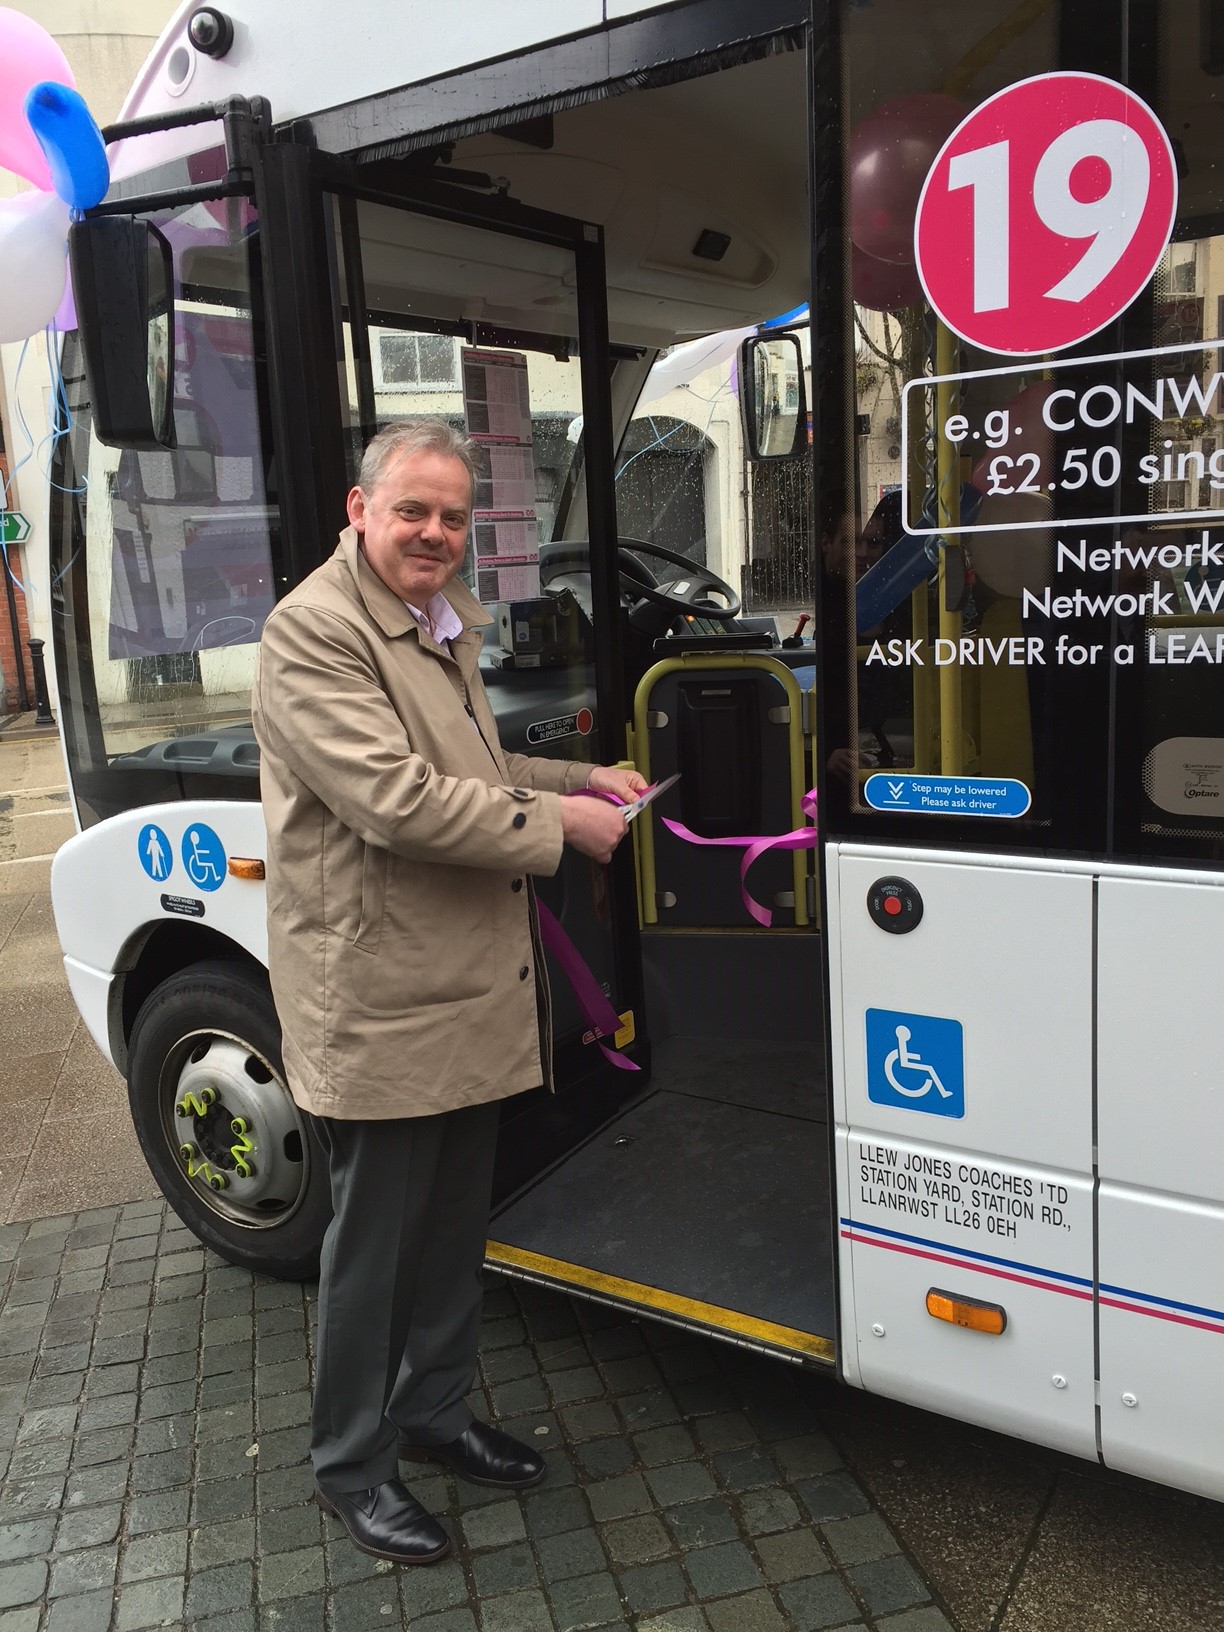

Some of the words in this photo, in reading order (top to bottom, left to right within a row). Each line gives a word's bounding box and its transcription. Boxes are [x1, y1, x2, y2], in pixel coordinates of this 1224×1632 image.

[948, 119, 1150, 313] 19
[944, 408, 1024, 449] e.g.
[1042, 372, 1224, 431] CONW
[986, 446, 1122, 496] £2.50
[1057, 530, 1224, 573] Network
[1022, 580, 1174, 619] Network
[865, 638, 925, 666] ASK
[934, 636, 1047, 666] DRIVER
[1055, 634, 1103, 665] for
[1114, 643, 1134, 665] a
[546, 721, 556, 730] HERE
[546, 727, 570, 737] EMERGENCY
[911, 782, 932, 793] Step
[934, 786, 952, 796] may
[954, 784, 966, 794] be
[968, 785, 1007, 797] lowered
[921, 796, 950, 807] Please
[951, 797, 967, 806] ask
[968, 798, 997, 809] driver
[1188, 789, 1220, 798] Optare
[859, 1144, 898, 1168] LLEW
[904, 1154, 952, 1179] JONES
[958, 1165, 1033, 1197] COACHES
[860, 1165, 918, 1194] STATION
[923, 1179, 965, 1207] YARD,
[971, 1190, 1034, 1221] STATION
[860, 1186, 938, 1219] LLANRWST
[944, 1205, 981, 1230] LL26
